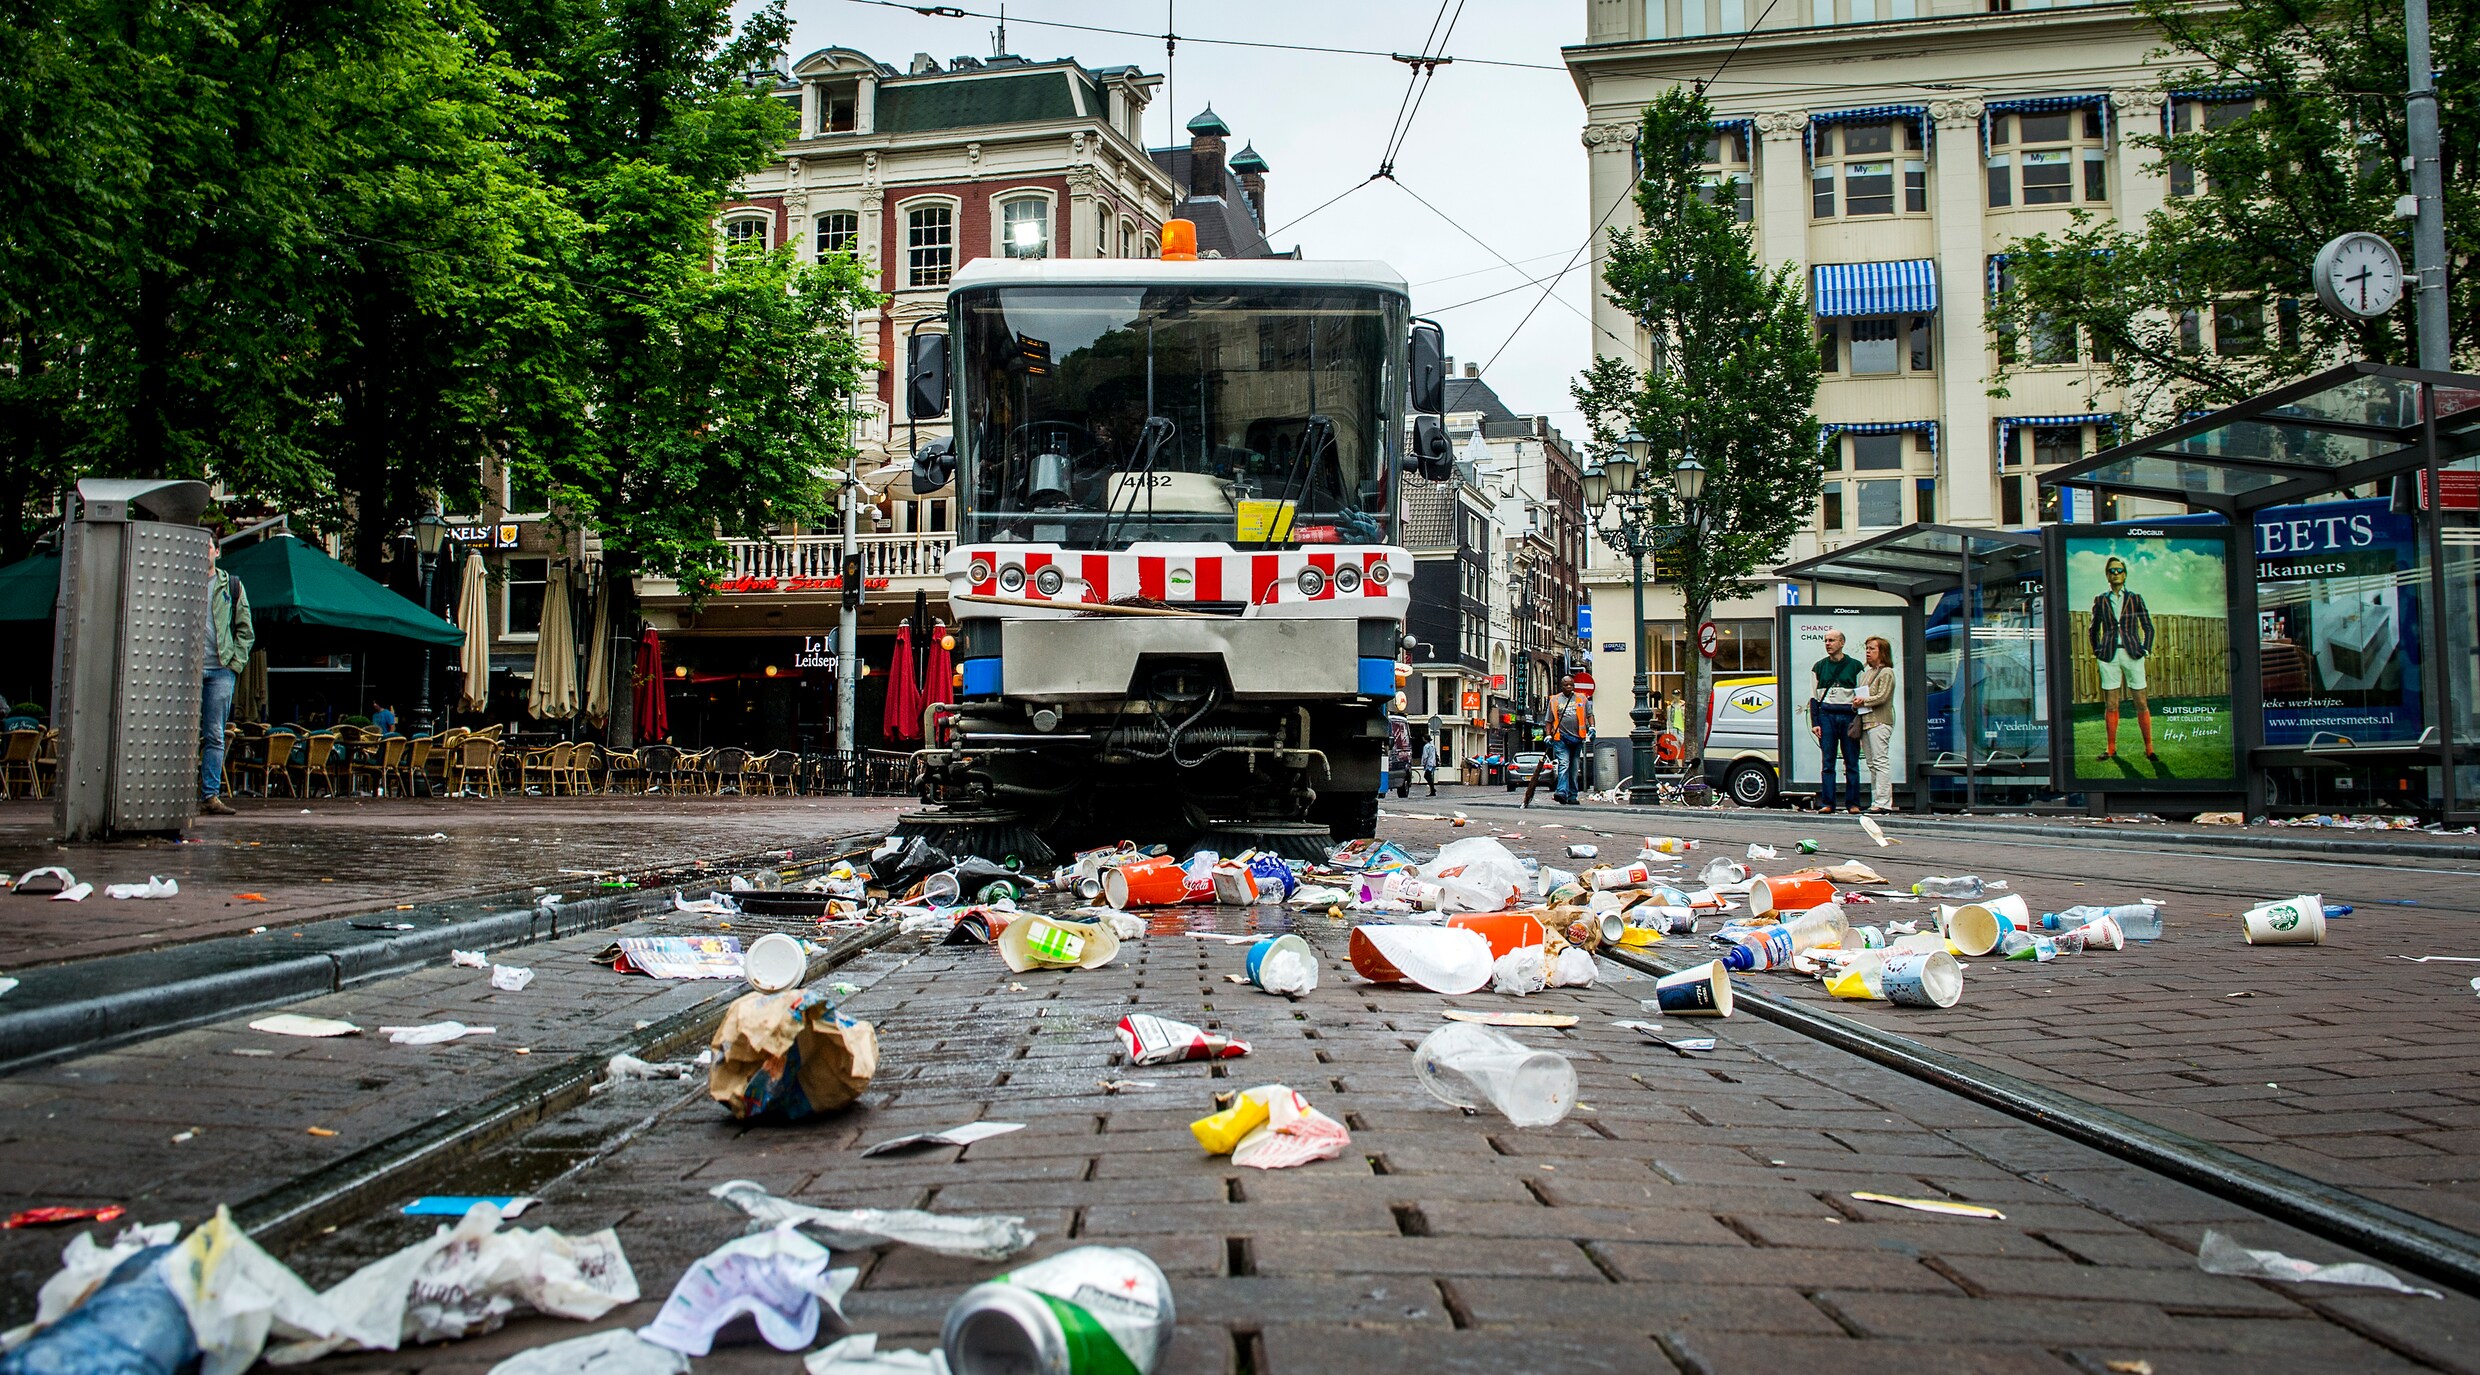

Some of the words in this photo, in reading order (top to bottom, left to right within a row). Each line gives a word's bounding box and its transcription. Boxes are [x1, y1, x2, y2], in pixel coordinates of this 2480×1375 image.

[2030, 153, 2061, 163] Mycall
[1854, 163, 1884, 175] Mycall
[1123, 476, 1172, 488] 4182
[444, 525, 492, 540] KELS'
[2127, 528, 2165, 536] JCDecaux
[2254, 515, 2373, 554] EETS
[2256, 562, 2346, 578] dkamers
[734, 575, 780, 592] York
[783, 574, 890, 591] Steakuse
[2020, 580, 2044, 594] Te
[805, 636, 820, 652] Le
[794, 653, 839, 672] Leidsep
[2262, 698, 2285, 708] ieke
[2288, 697, 2344, 708] werkwijze.
[2162, 706, 2217, 714] SUITSUPPLY
[2268, 712, 2394, 727] www.meestersmeets.nl
[1569, 928, 1587, 940] KING
